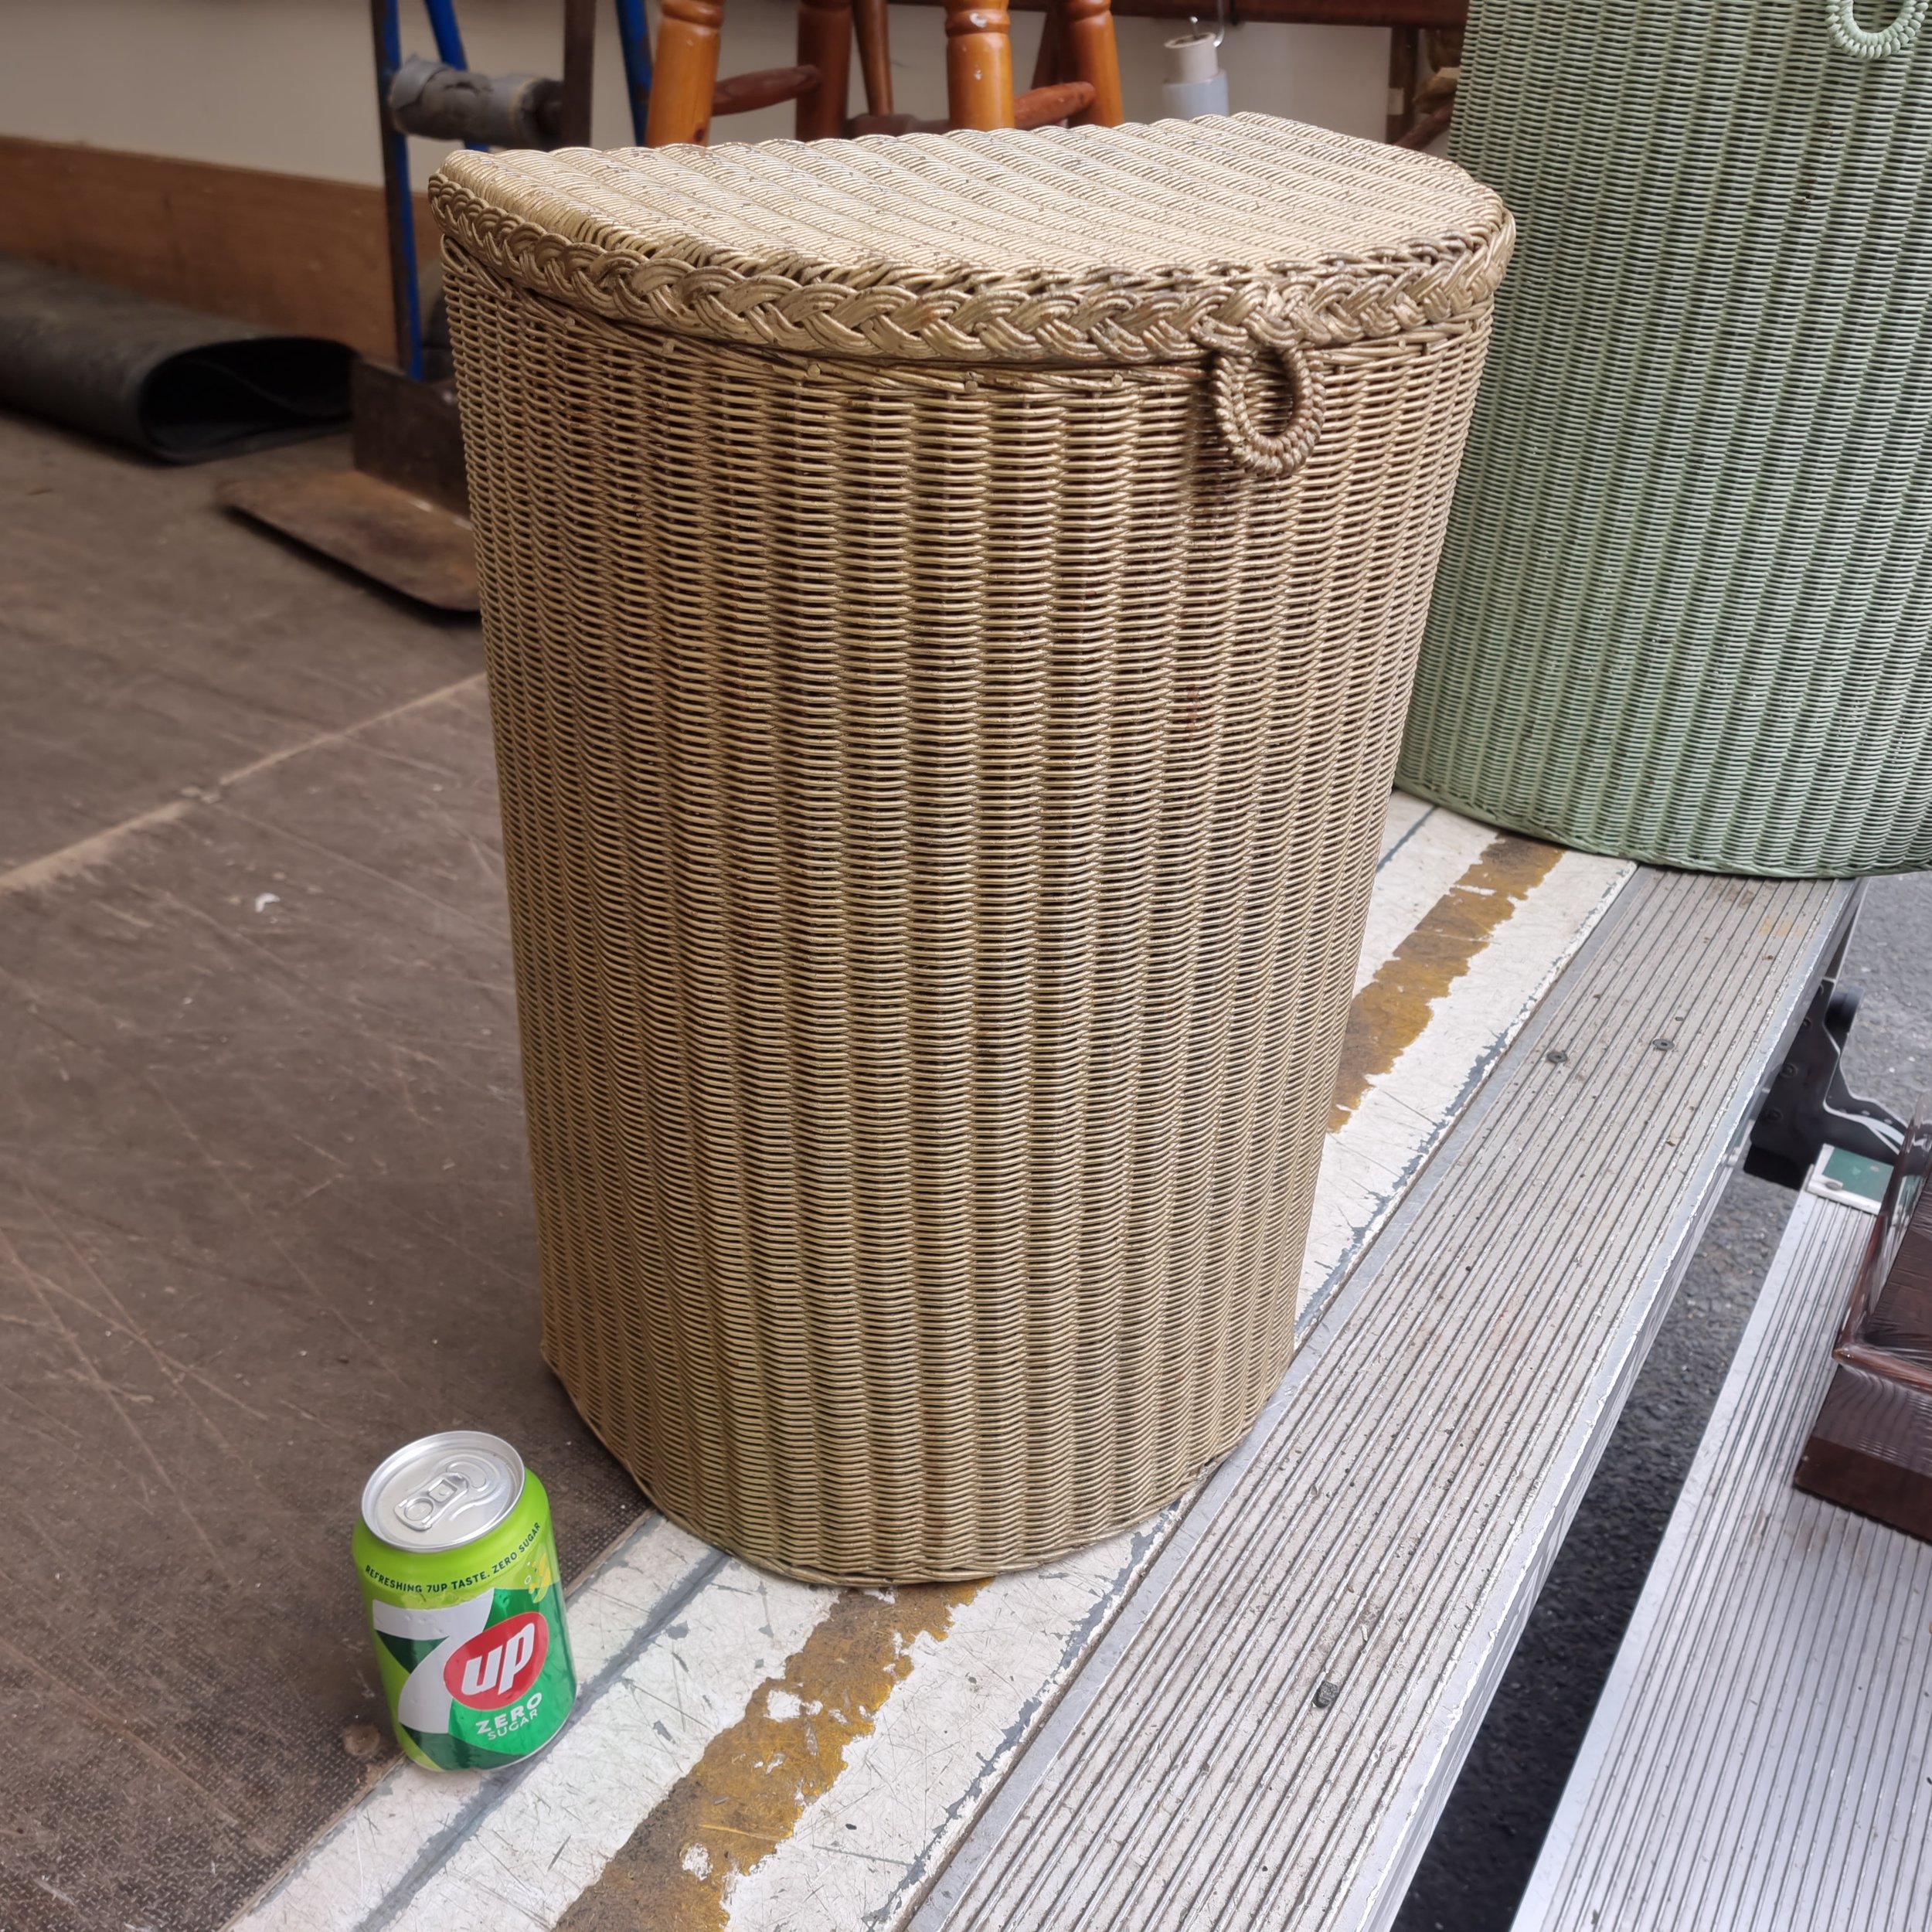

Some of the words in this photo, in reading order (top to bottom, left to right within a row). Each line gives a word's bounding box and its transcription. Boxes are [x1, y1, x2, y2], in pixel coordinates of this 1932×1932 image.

[365, 1564, 423, 1593] REFRESHING
[427, 1583, 448, 1593] 7UP
[451, 1571, 491, 1590] TASTE.
[492, 1552, 518, 1574] ZERO
[518, 1522, 542, 1553] SUGAR
[475, 1692, 543, 1735] ZERO
[488, 1708, 539, 1740] SUGAR
